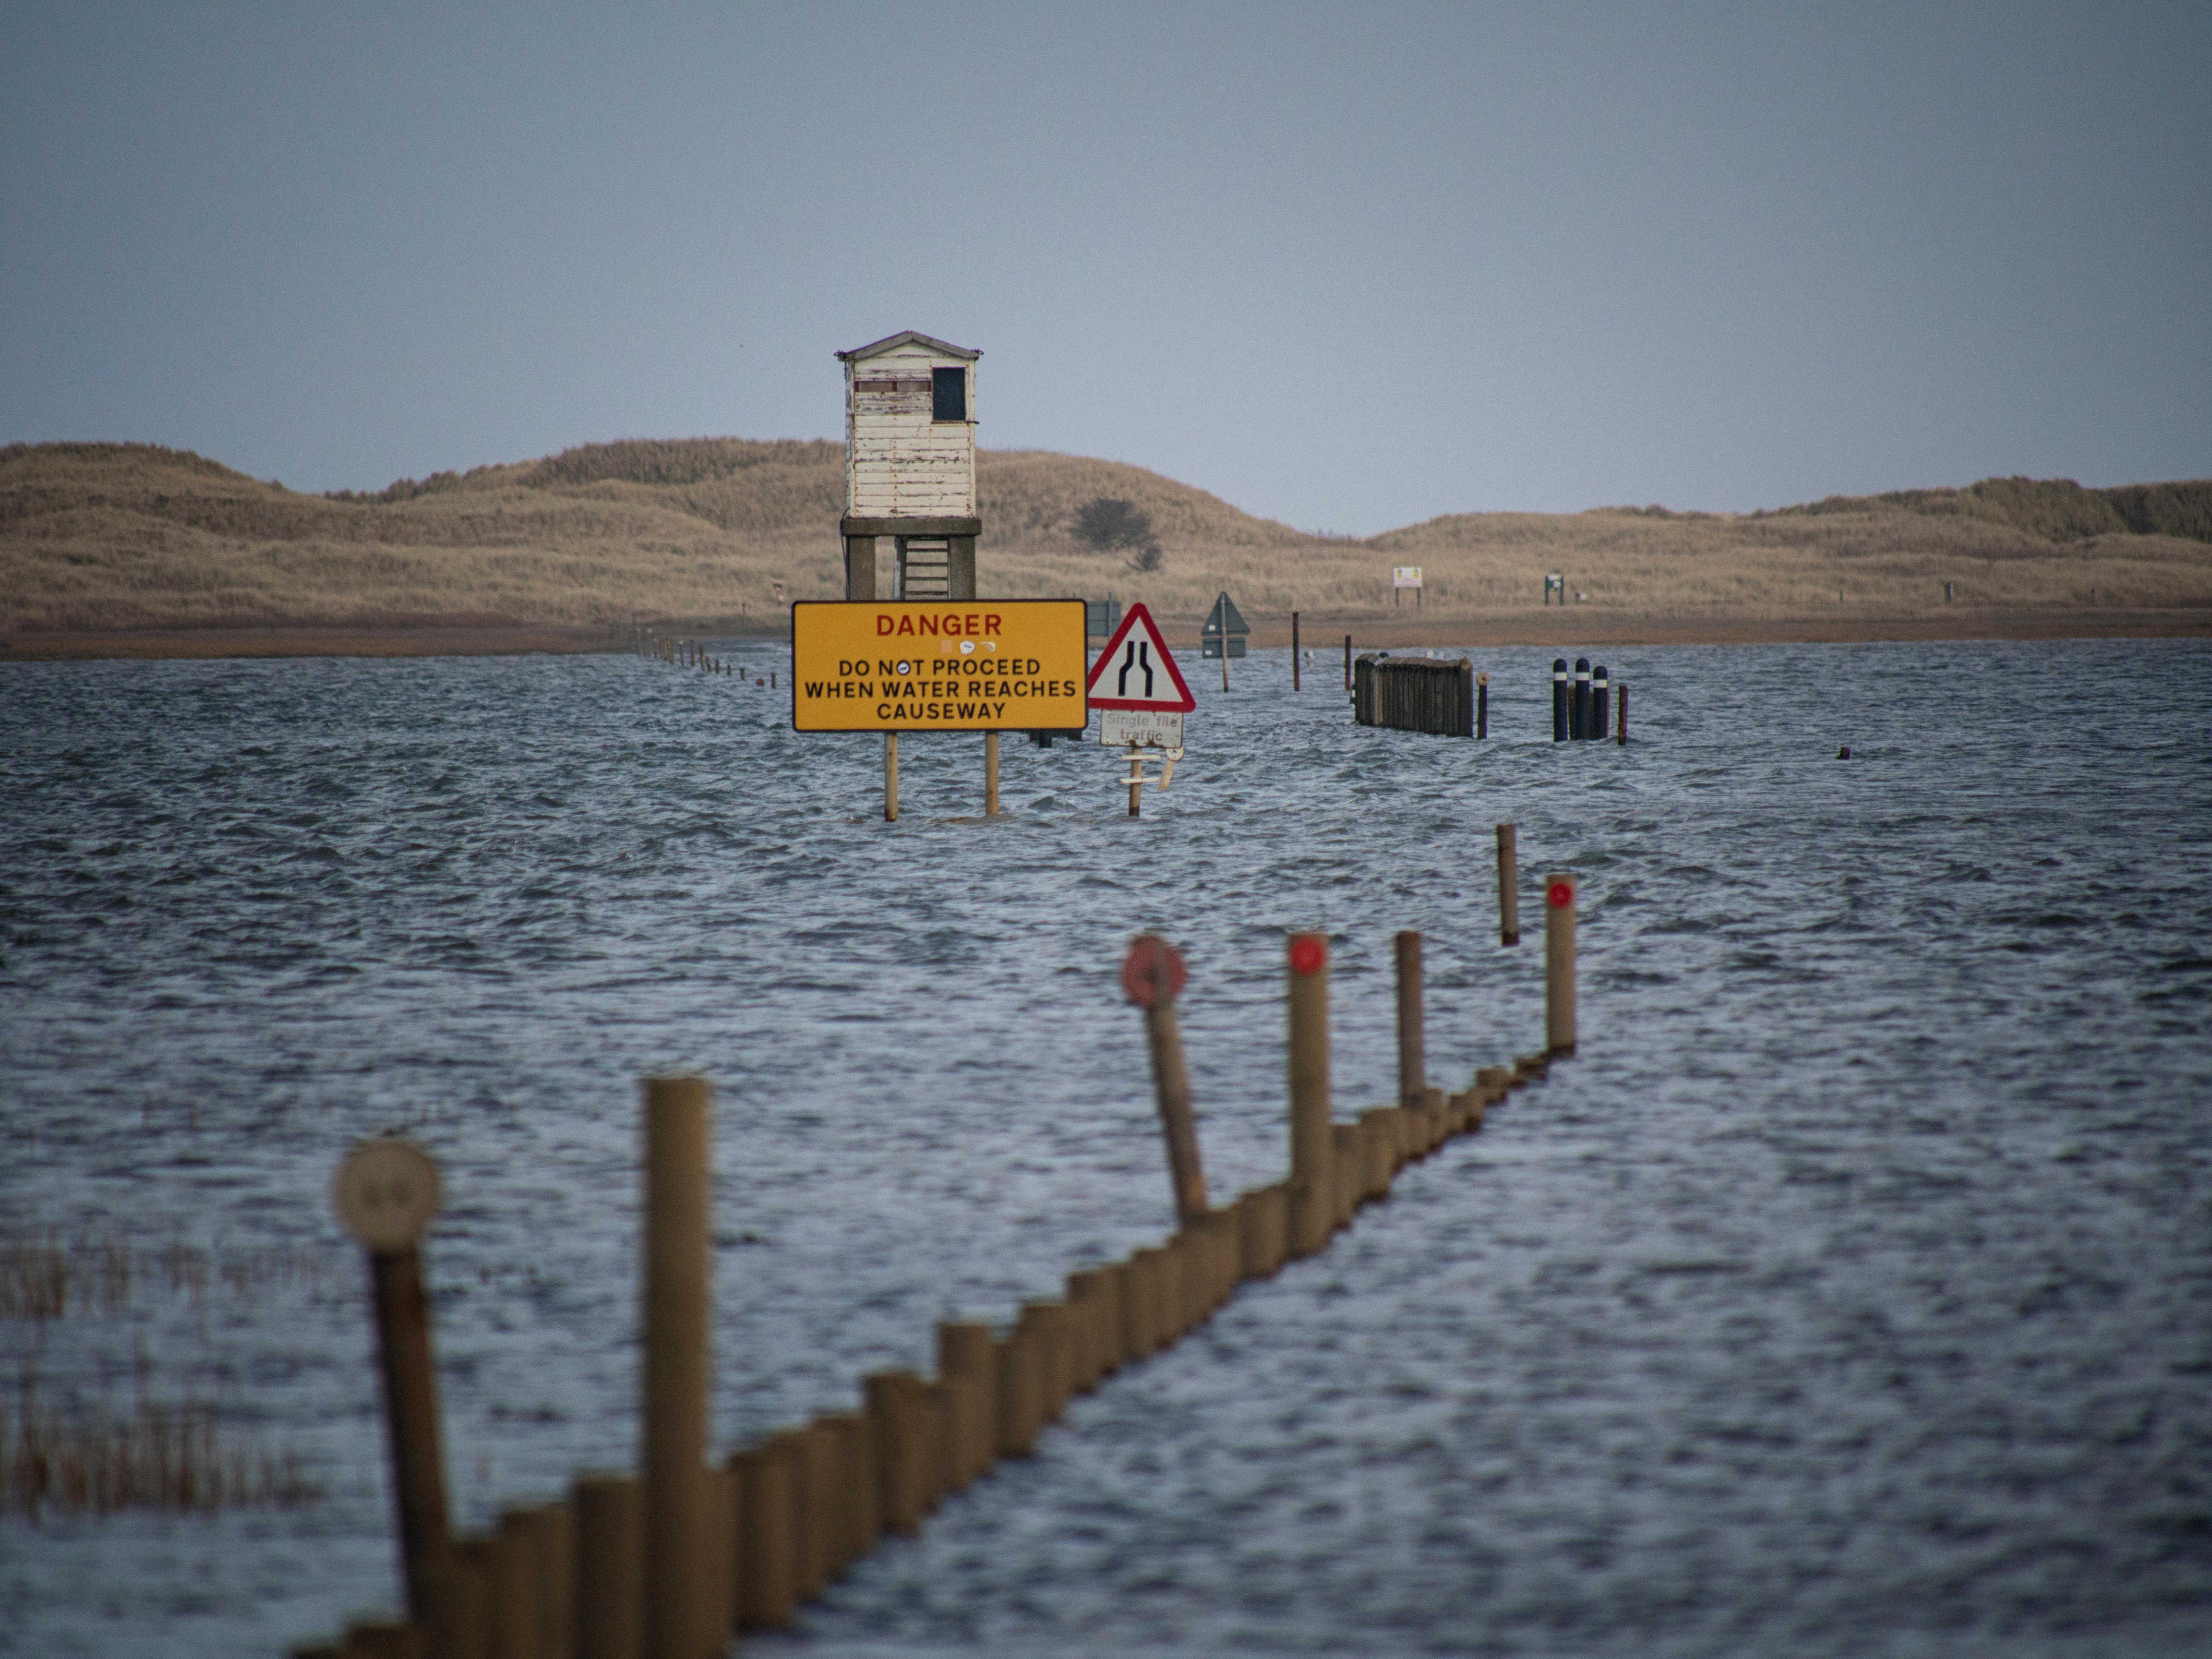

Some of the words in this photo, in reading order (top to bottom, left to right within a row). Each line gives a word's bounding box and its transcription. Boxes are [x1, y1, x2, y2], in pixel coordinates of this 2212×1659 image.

[877, 614, 1002, 636] DANGER
[839, 660, 869, 676] DO
[879, 660, 925, 676] NOT
[933, 659, 1040, 675] PROCEED
[805, 682, 874, 698] WHEN
[882, 681, 959, 698] WATER
[968, 680, 1076, 697] REACHES
[877, 703, 1006, 720] CAUSEWAY
[1106, 713, 1149, 728] Single
[1156, 716, 1178, 727] file
[1120, 729, 1163, 741] traffic
